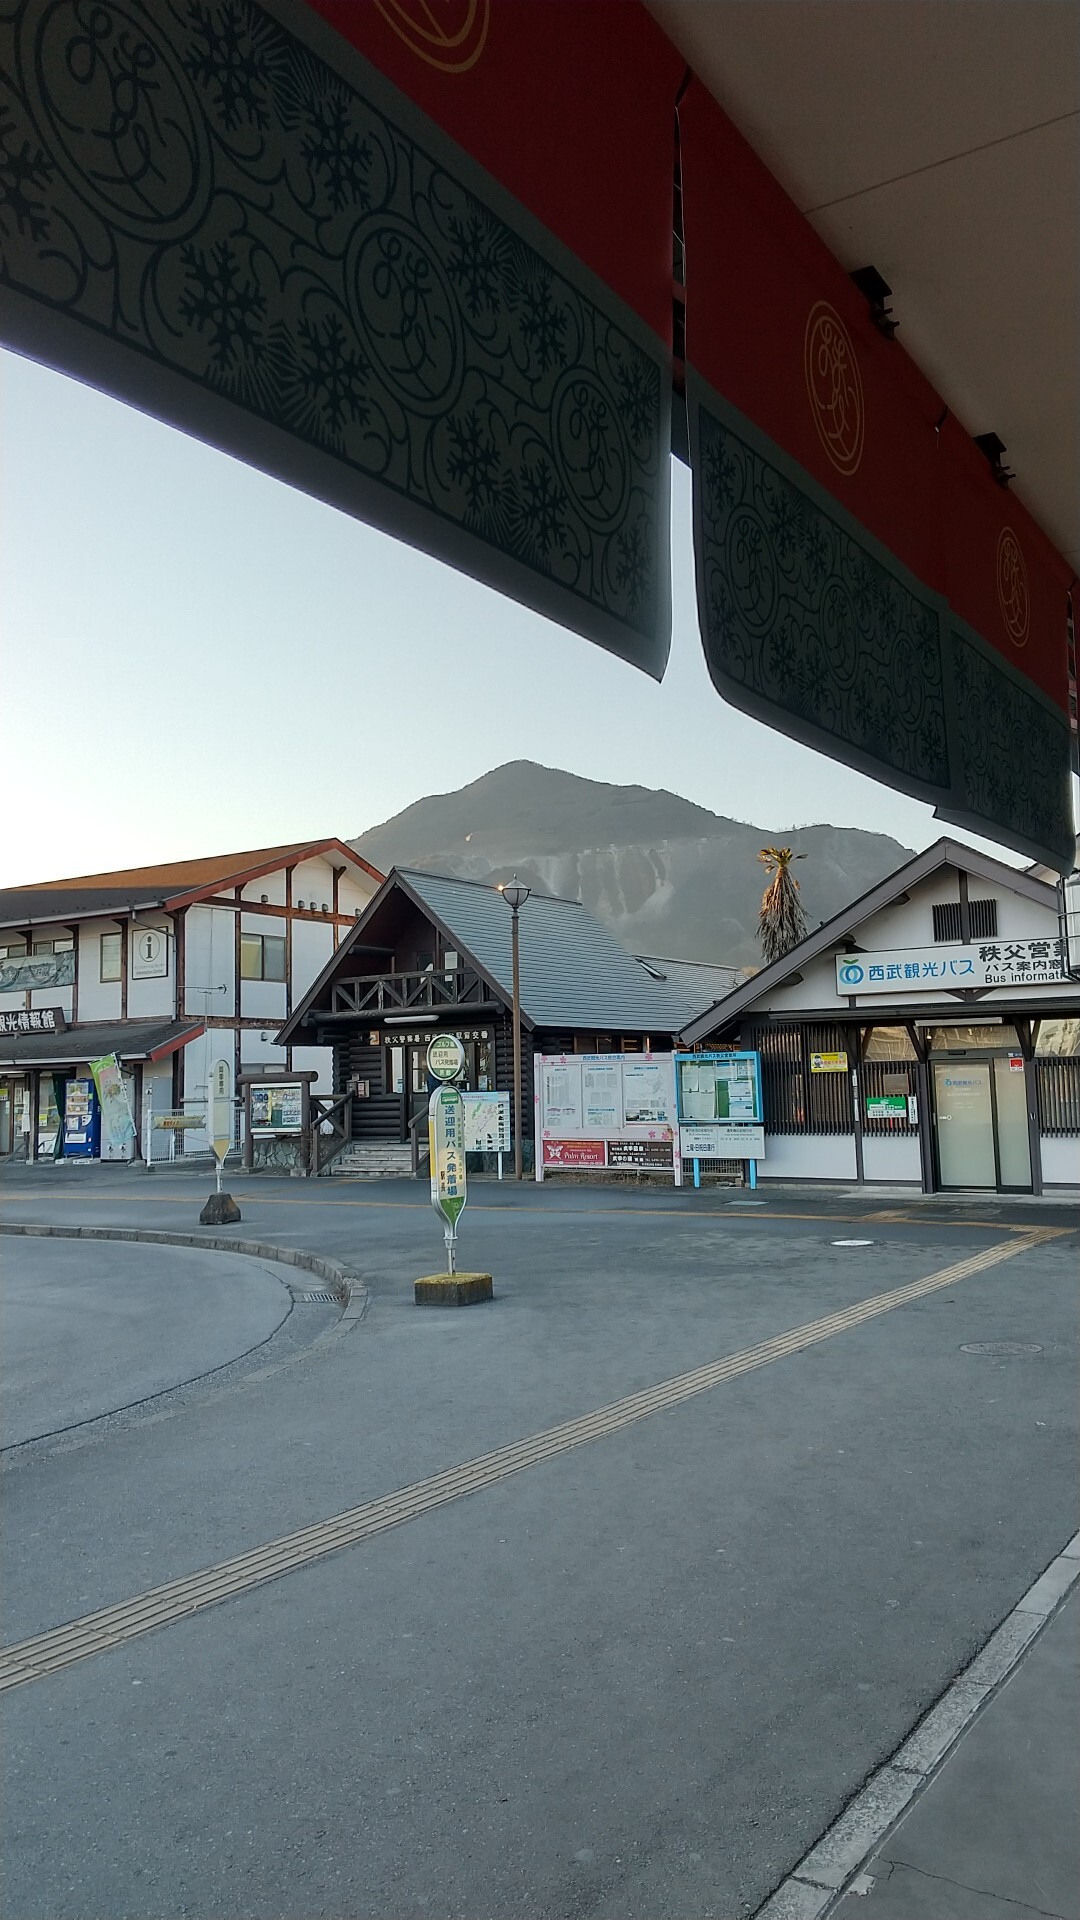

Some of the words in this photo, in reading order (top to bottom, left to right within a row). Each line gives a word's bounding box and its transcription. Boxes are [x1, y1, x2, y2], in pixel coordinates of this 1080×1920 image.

[869, 959, 975, 981] 西武観光バス
[984, 973, 1007, 984] Bus
[444, 1105, 458, 1196] 送迎用バス発着場
